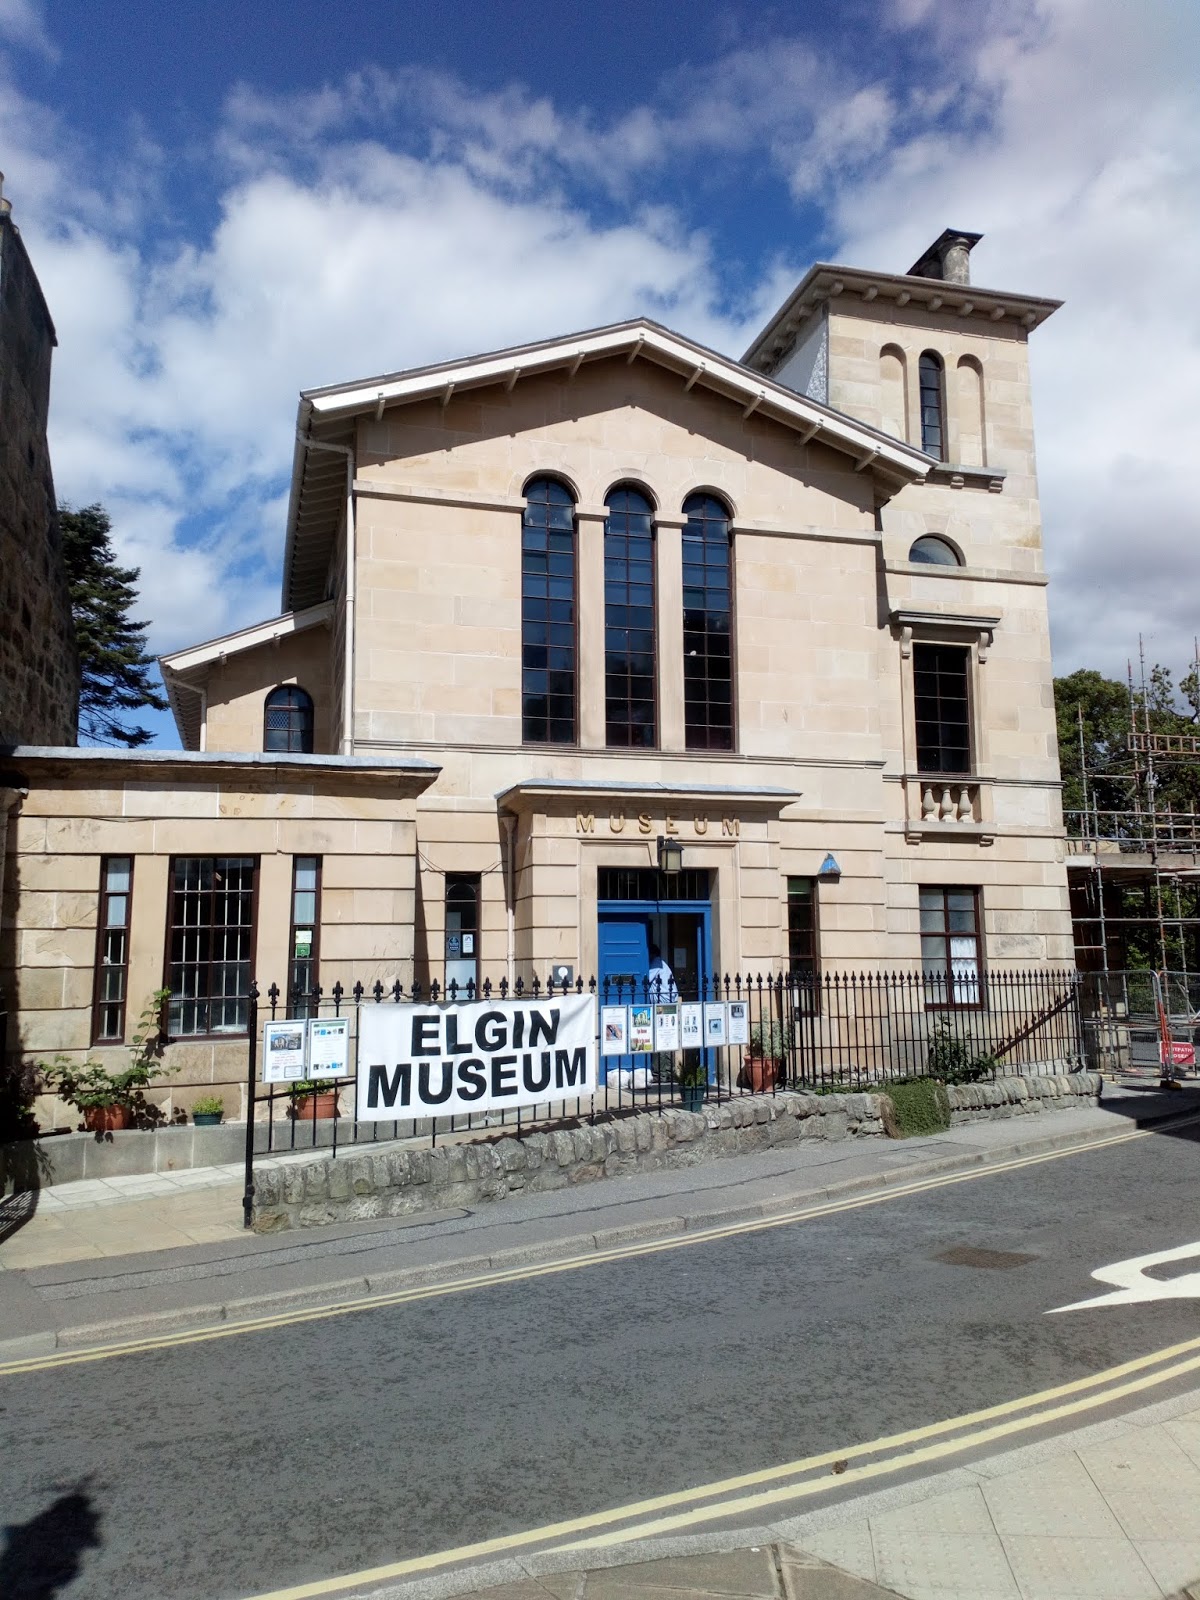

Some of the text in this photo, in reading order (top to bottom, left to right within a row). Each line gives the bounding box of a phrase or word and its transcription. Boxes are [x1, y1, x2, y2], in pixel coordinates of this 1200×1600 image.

[576, 811, 740, 836] MUSEUM
[411, 1008, 560, 1057] ELGIN
[367, 1046, 587, 1108] MUSEUM
